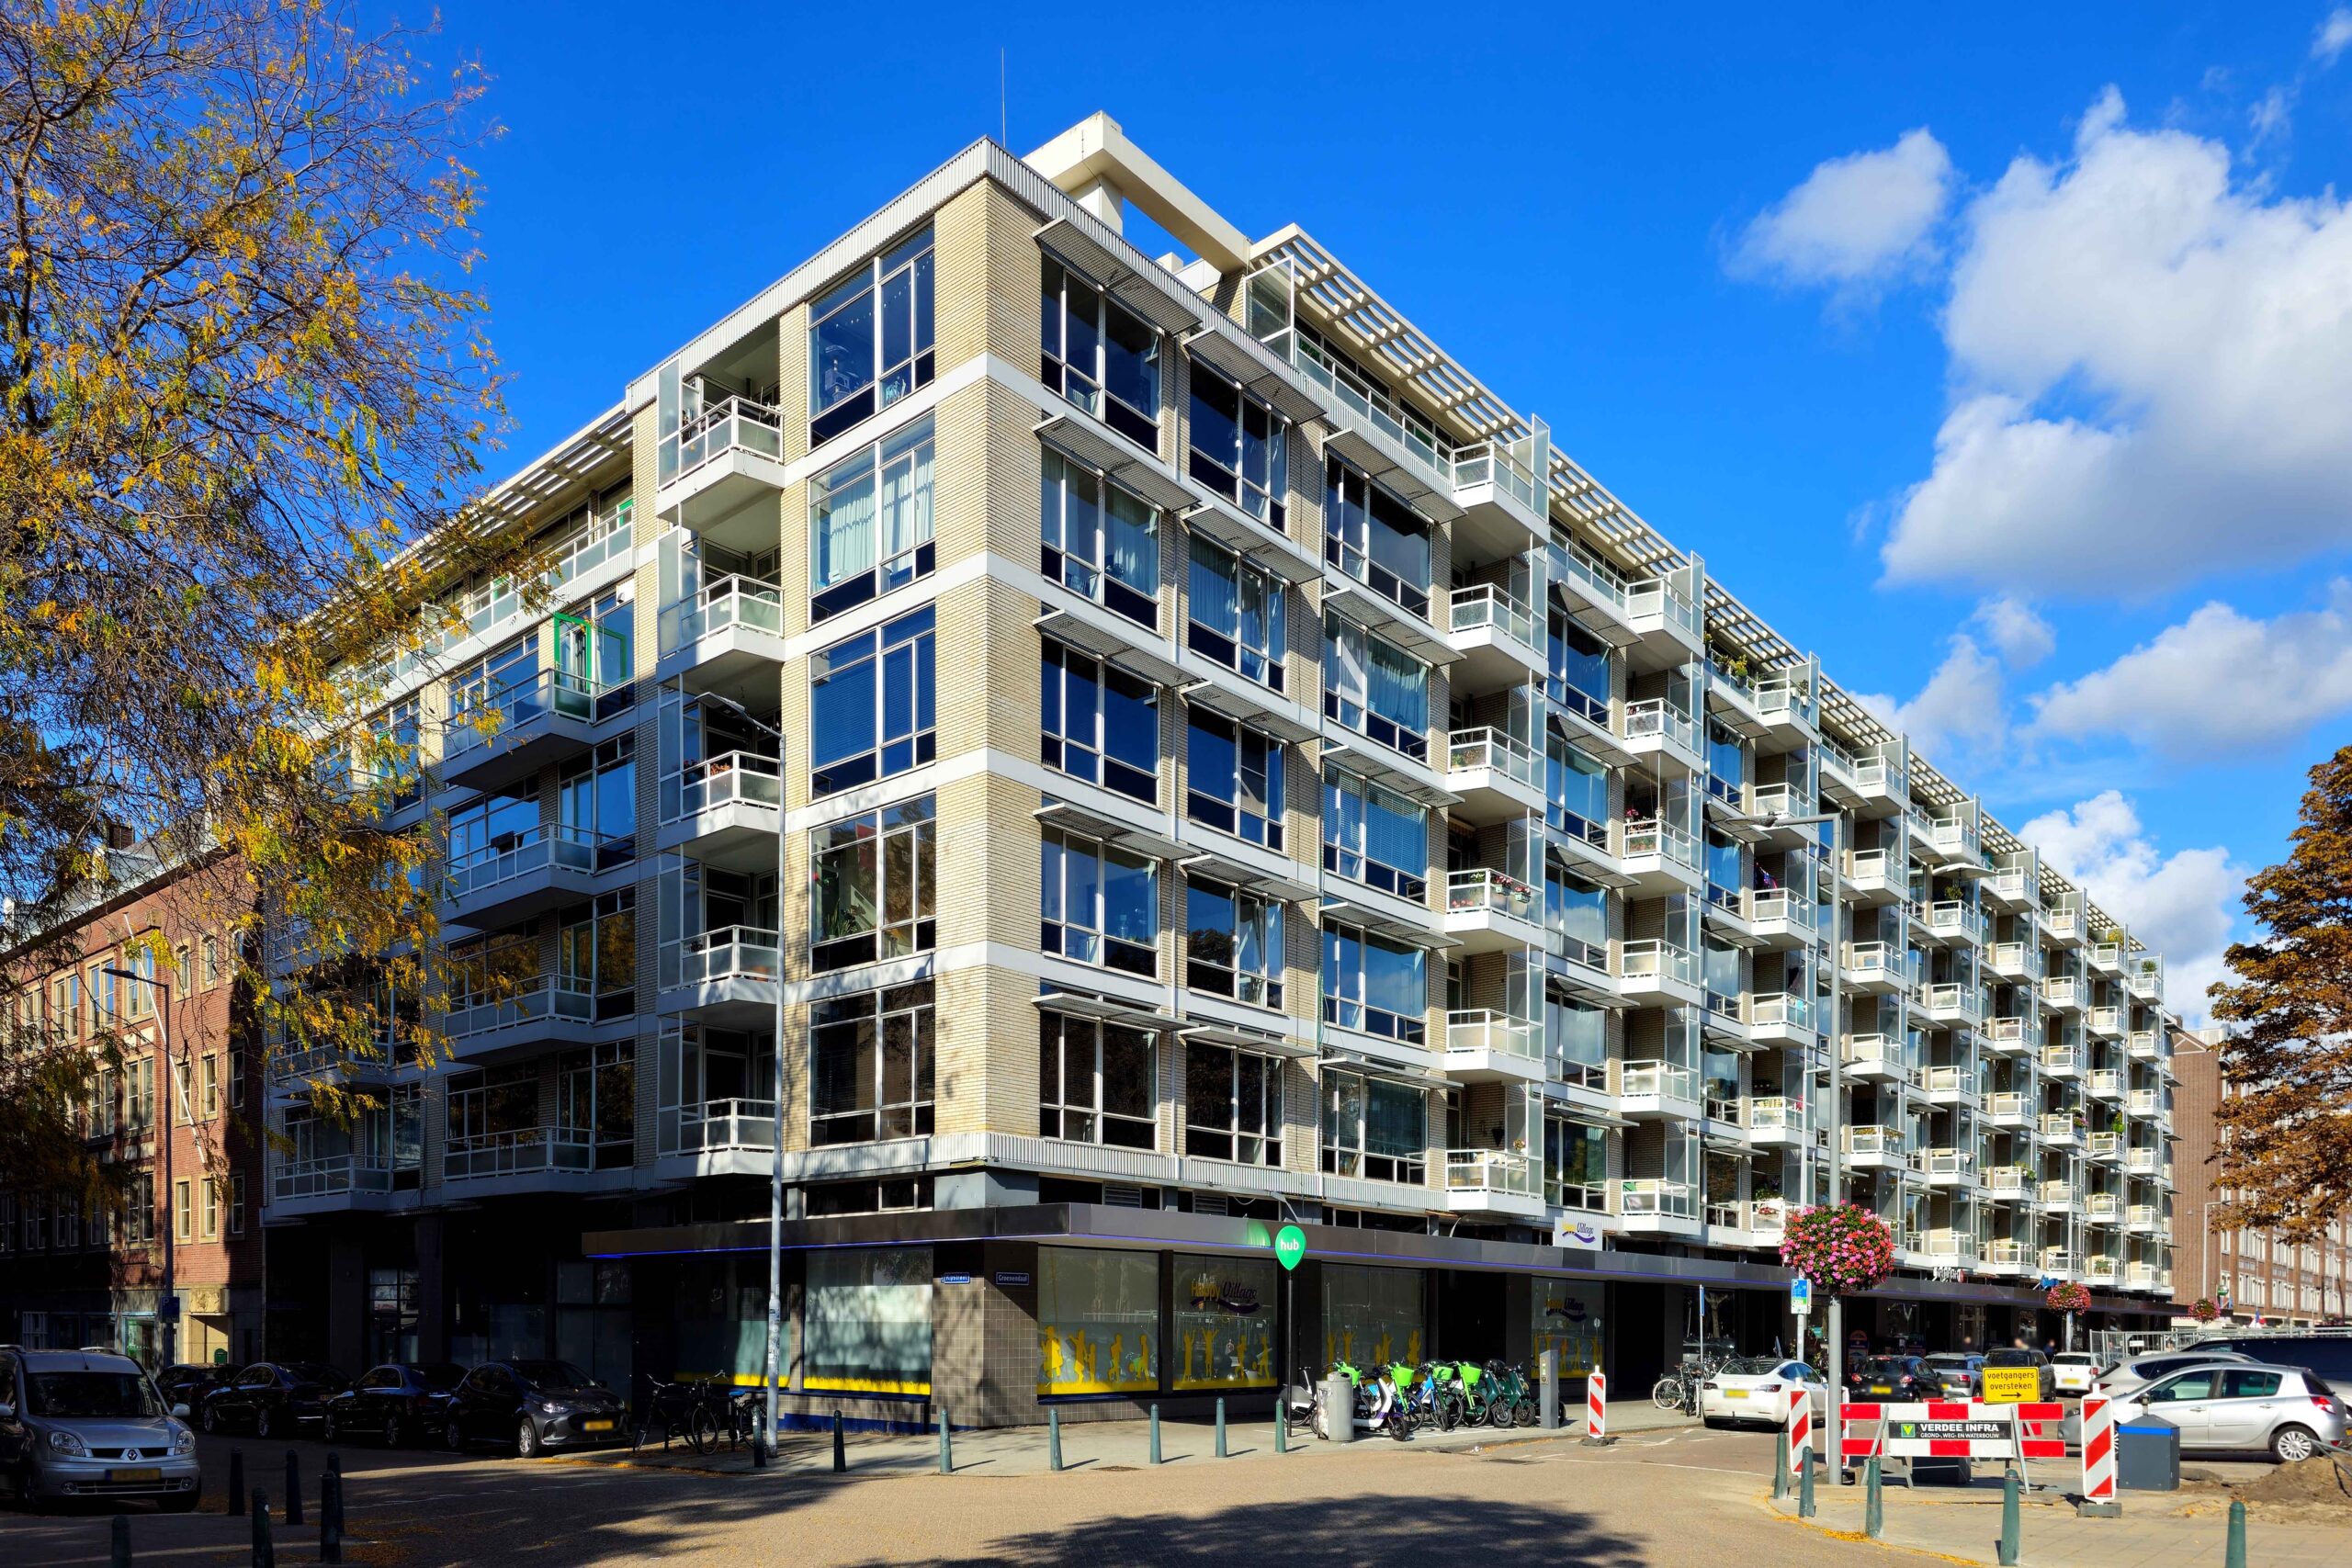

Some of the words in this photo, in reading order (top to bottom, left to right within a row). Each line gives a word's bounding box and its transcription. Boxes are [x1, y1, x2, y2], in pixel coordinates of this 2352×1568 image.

[1281, 1238, 1299, 1250] hub
[1987, 1371, 2035, 1381] voetgangers
[1990, 1382, 2032, 1390] oversteken
[1920, 1424, 1962, 1432] VERDEE
[1966, 1424, 1999, 1432] INFRA
